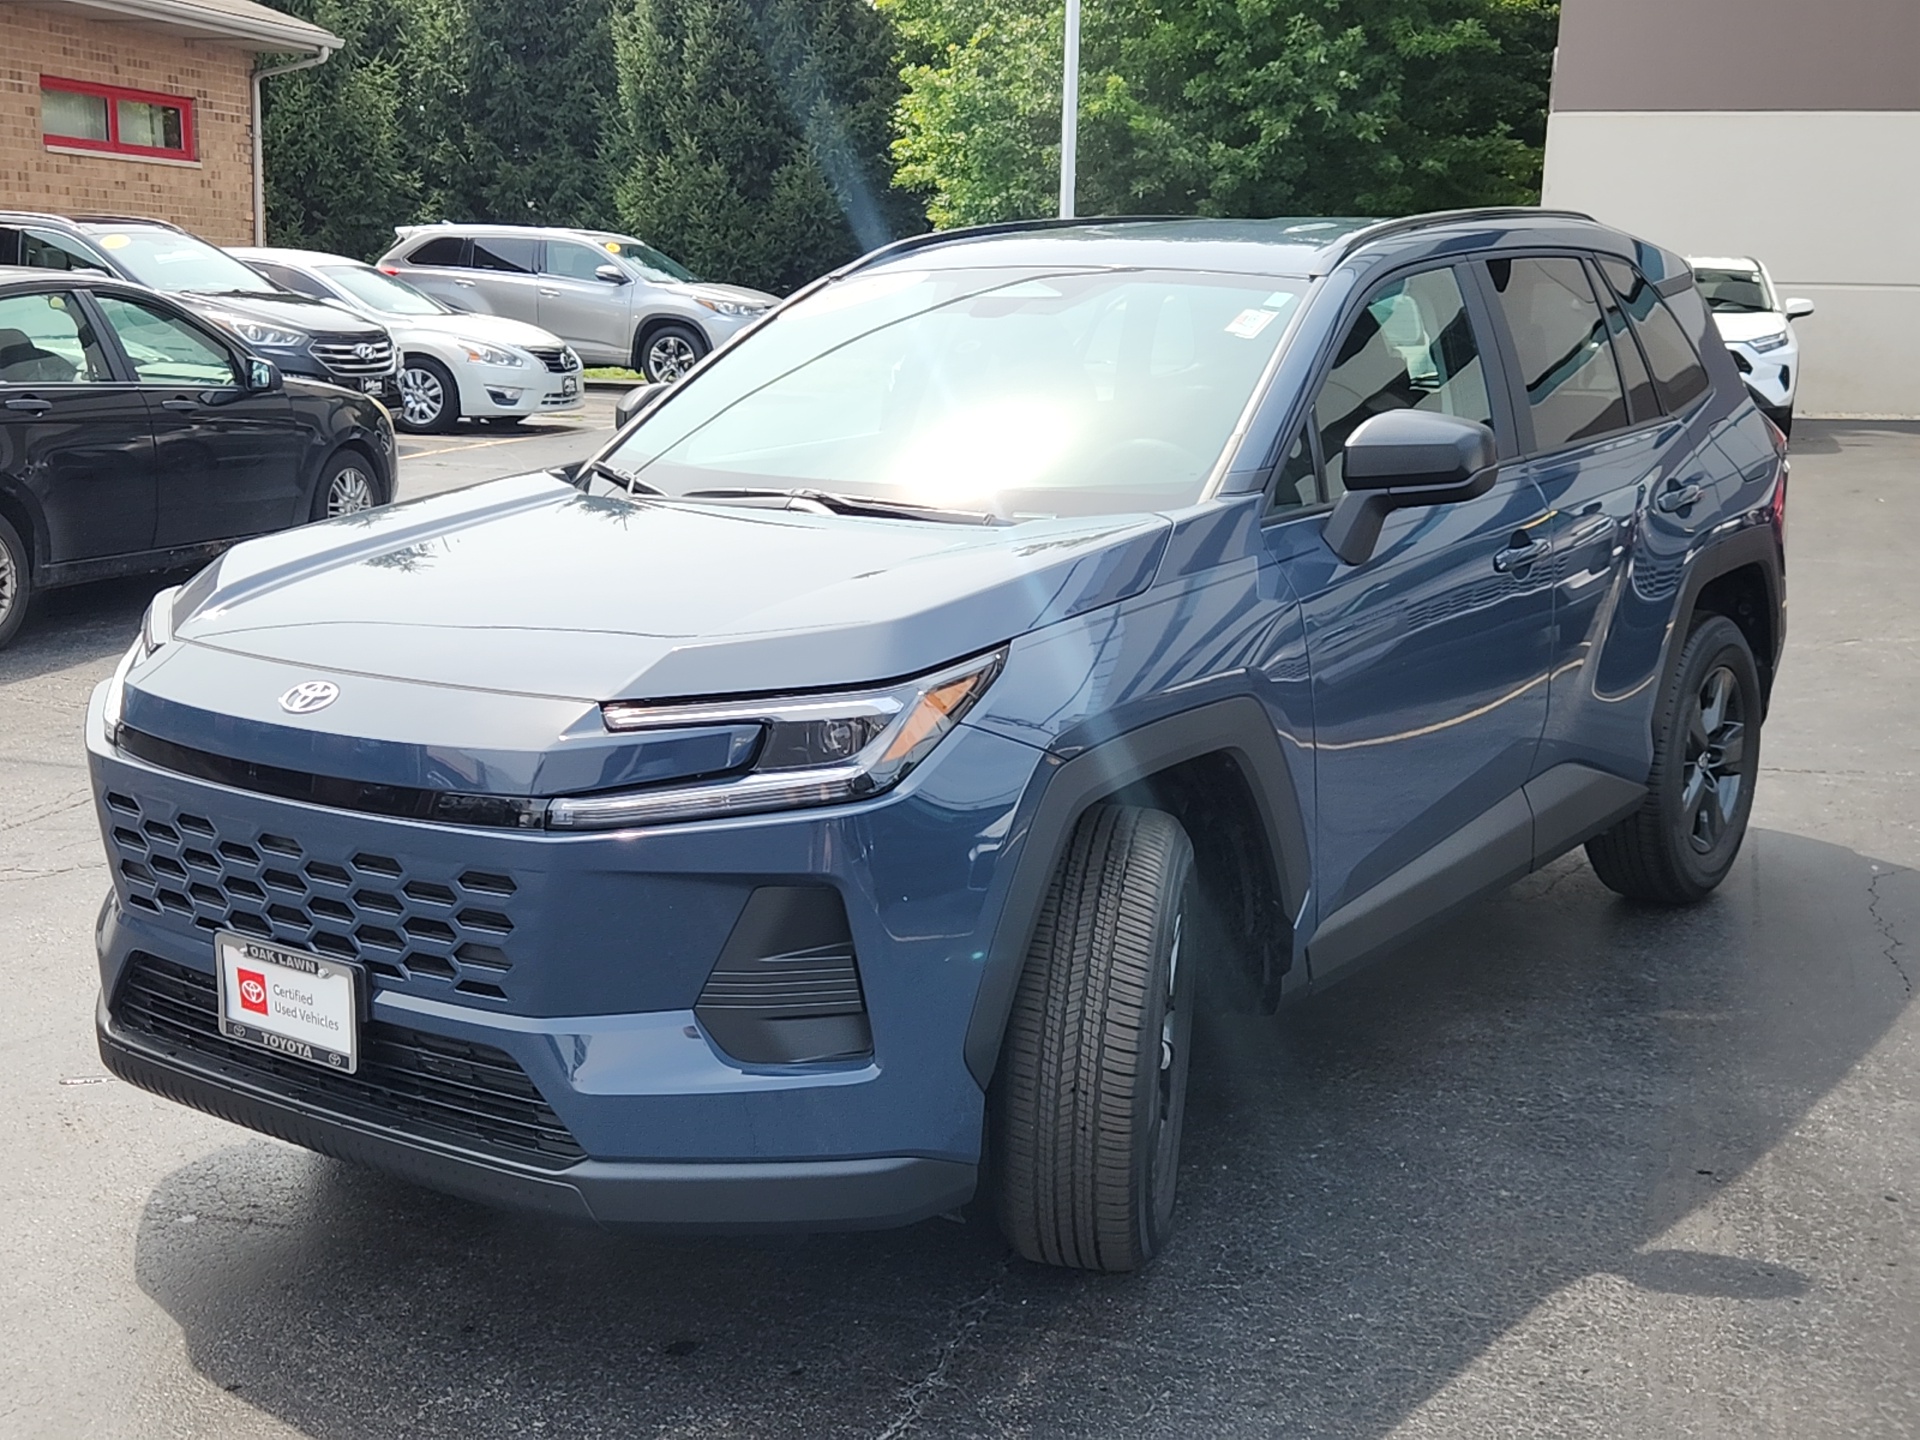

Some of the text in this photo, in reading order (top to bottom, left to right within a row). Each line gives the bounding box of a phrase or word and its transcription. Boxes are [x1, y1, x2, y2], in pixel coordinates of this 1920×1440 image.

[250, 946, 316, 973] OAK LAWN
[273, 984, 313, 1006] Certified
[274, 1001, 339, 1031] Used Vehicles
[261, 1032, 313, 1058] TOYOTA
